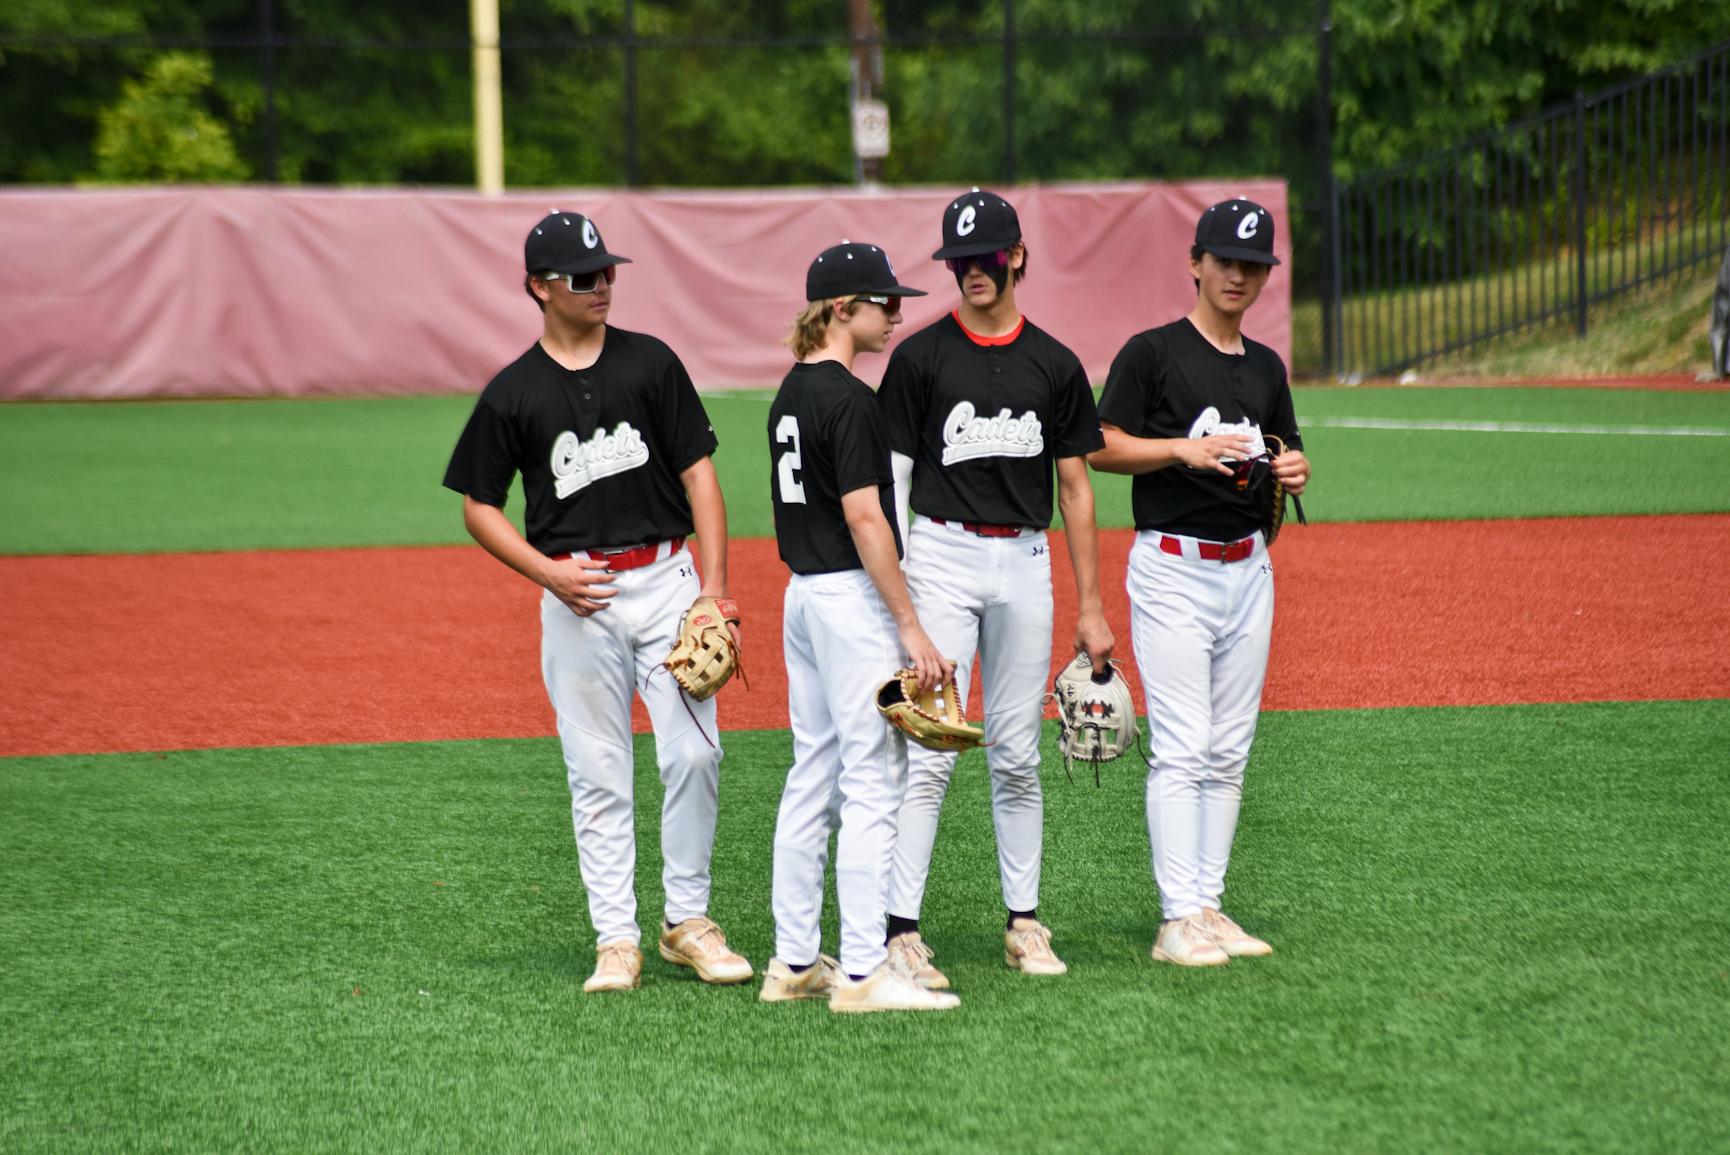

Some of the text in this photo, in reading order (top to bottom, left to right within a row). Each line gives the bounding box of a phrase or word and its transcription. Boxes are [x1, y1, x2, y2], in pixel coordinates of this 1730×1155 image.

[581, 219, 599, 250] C
[956, 204, 977, 237] C
[1236, 211, 1259, 240] C
[943, 400, 1043, 446] Cadets
[551, 421, 646, 479] Cadets
[775, 415, 807, 505] 2
